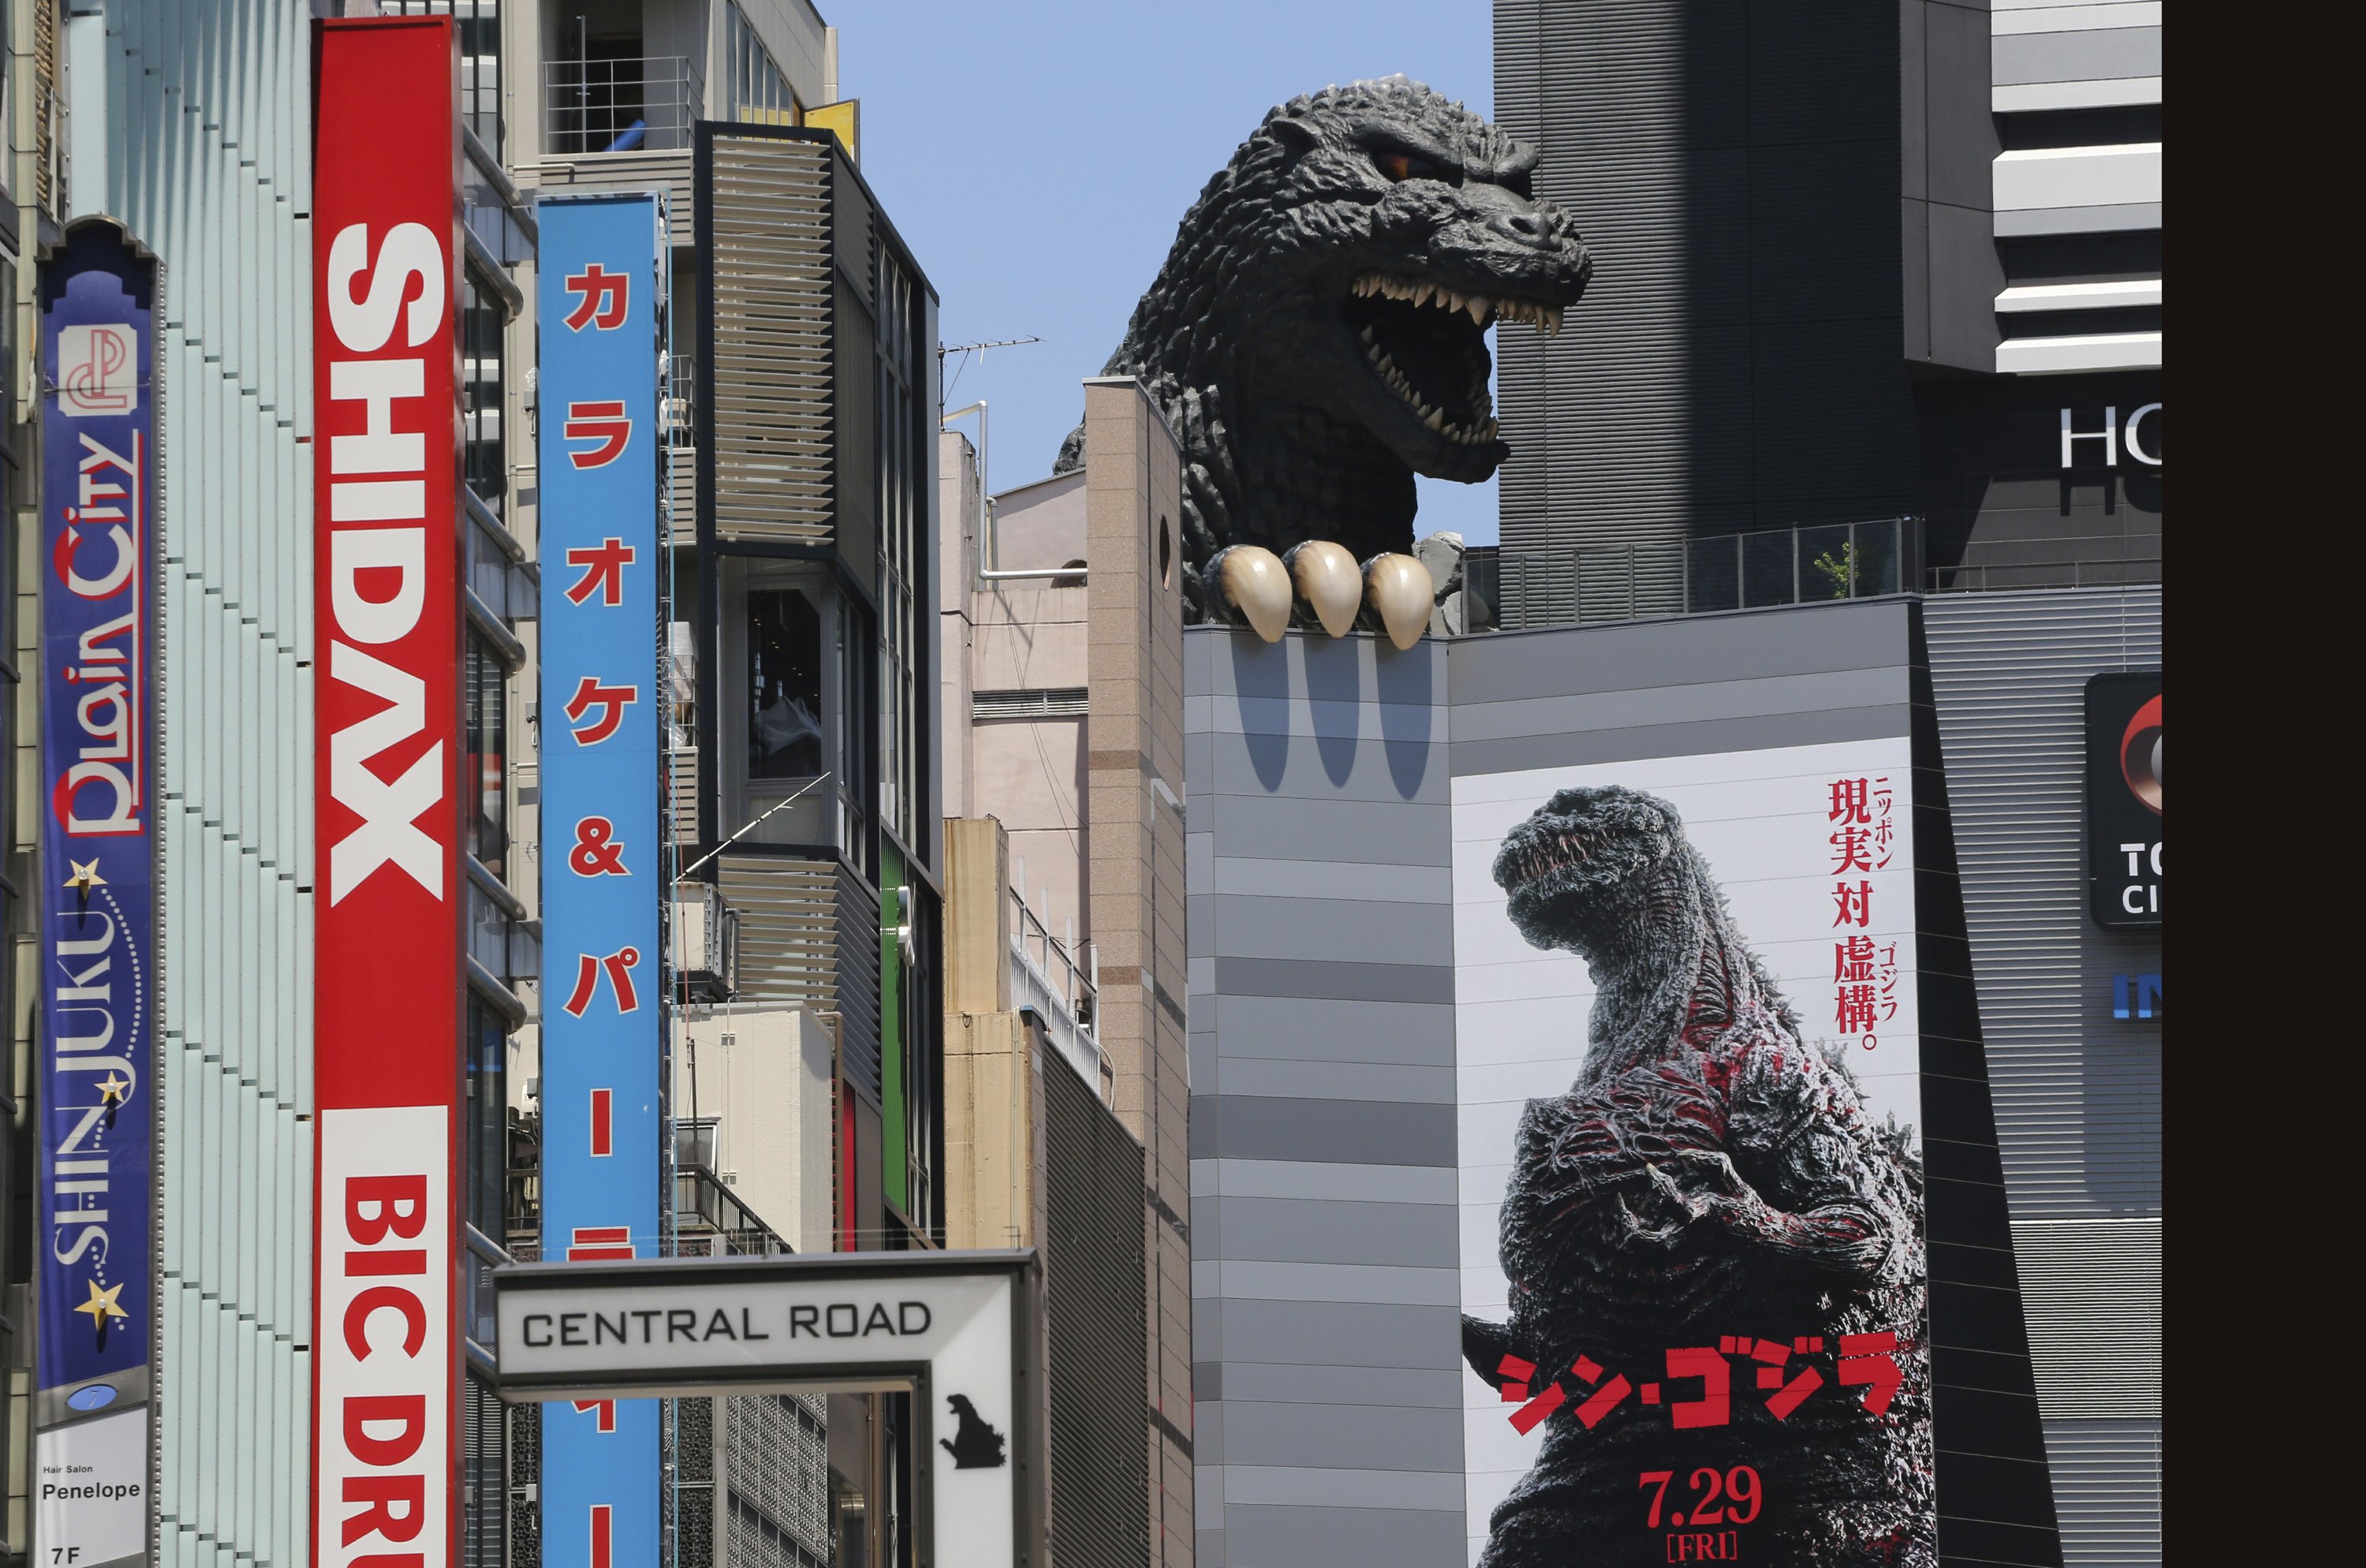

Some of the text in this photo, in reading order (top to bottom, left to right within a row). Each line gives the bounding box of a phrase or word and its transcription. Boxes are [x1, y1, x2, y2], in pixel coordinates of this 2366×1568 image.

[328, 222, 445, 908] SHIDAX
[1872, 776, 1894, 870] ニッポン
[2122, 884, 2158, 914] CI
[1879, 941, 1898, 1021] ゴジラ
[54, 910, 136, 1266] SHINJUKU
[522, 1301, 931, 1347] CENTRAL ROAD
[342, 1174, 427, 1568] BIC DR
[43, 1465, 93, 1474] Hair Salon
[43, 1482, 140, 1501] Penelope
[1639, 1465, 1762, 1529] 7.29
[51, 1547, 80, 1566] 7F
[1666, 1530, 1737, 1563] [FRI]
